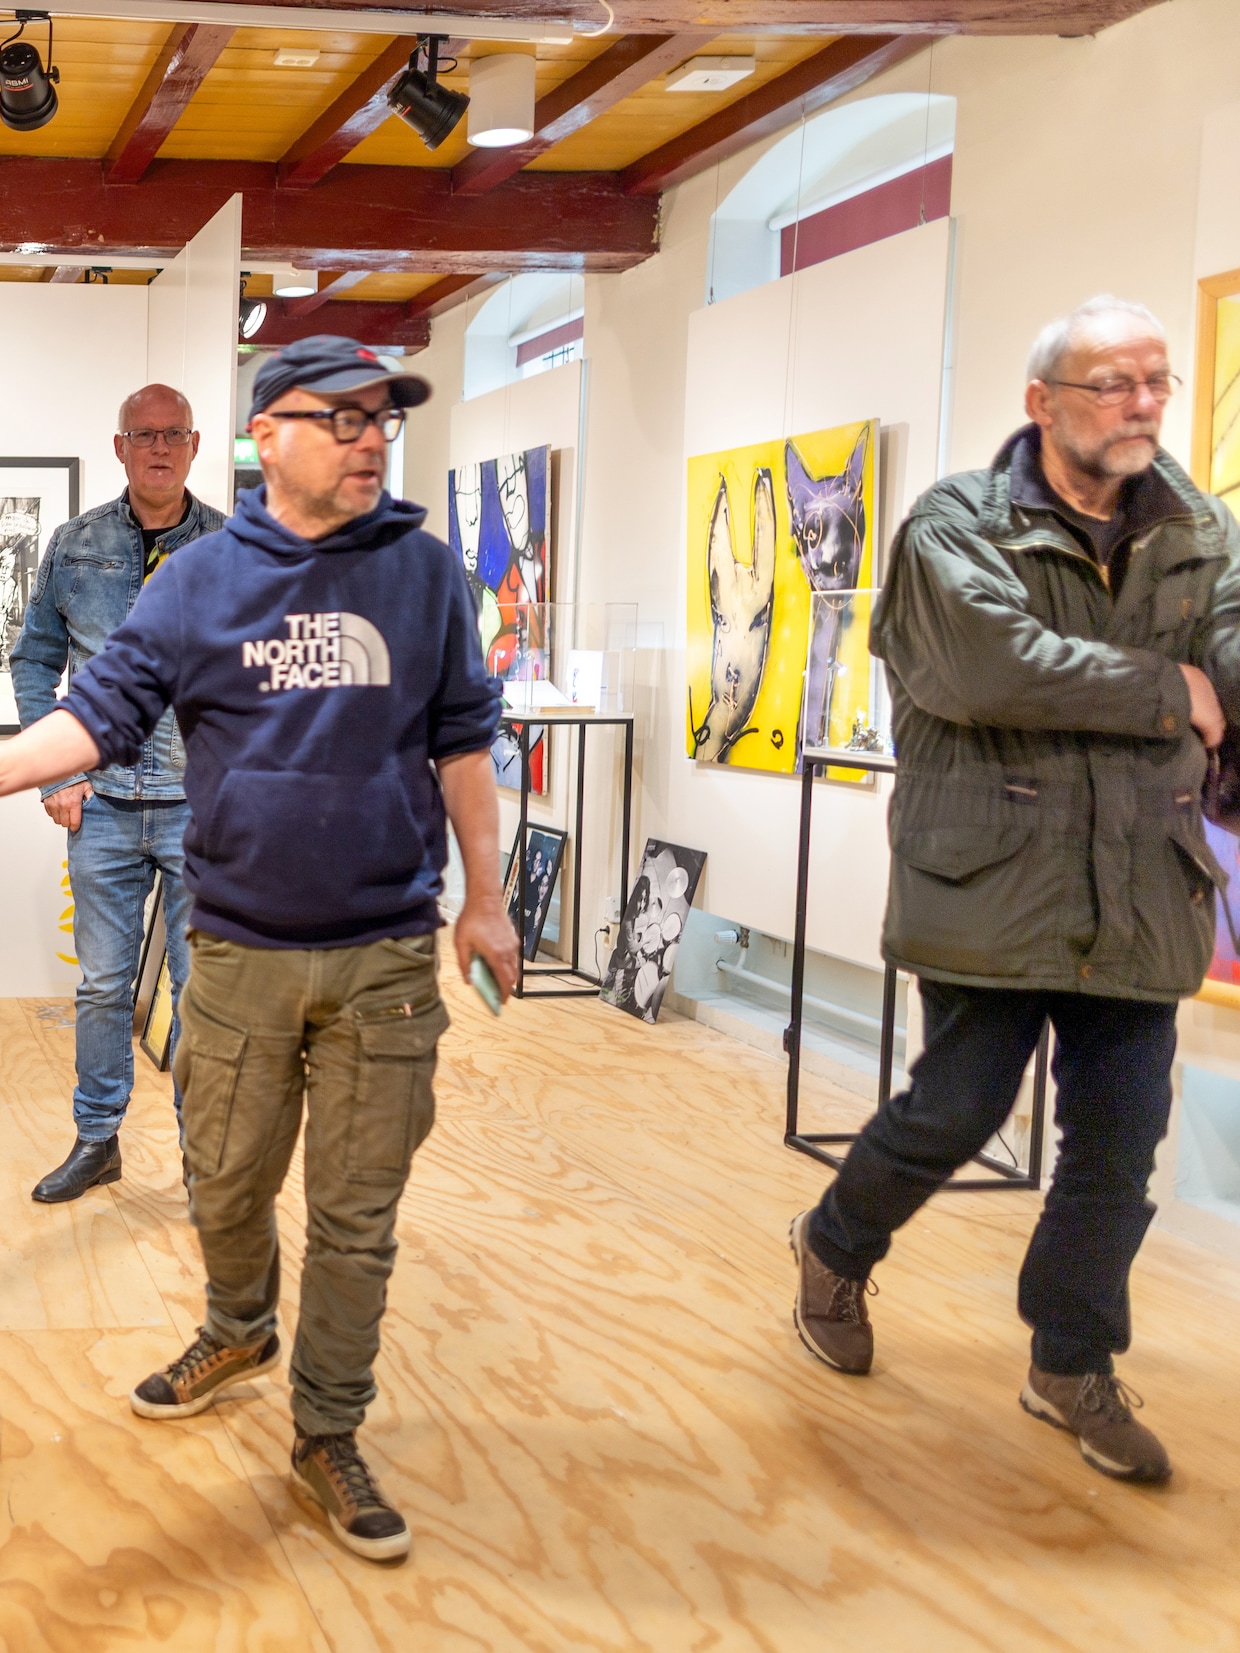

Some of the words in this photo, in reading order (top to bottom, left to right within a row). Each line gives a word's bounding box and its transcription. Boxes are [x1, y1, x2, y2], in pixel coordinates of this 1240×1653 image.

[284, 612, 340, 639] THE
[242, 637, 341, 668] NORTH
[271, 661, 341, 690] FACE
